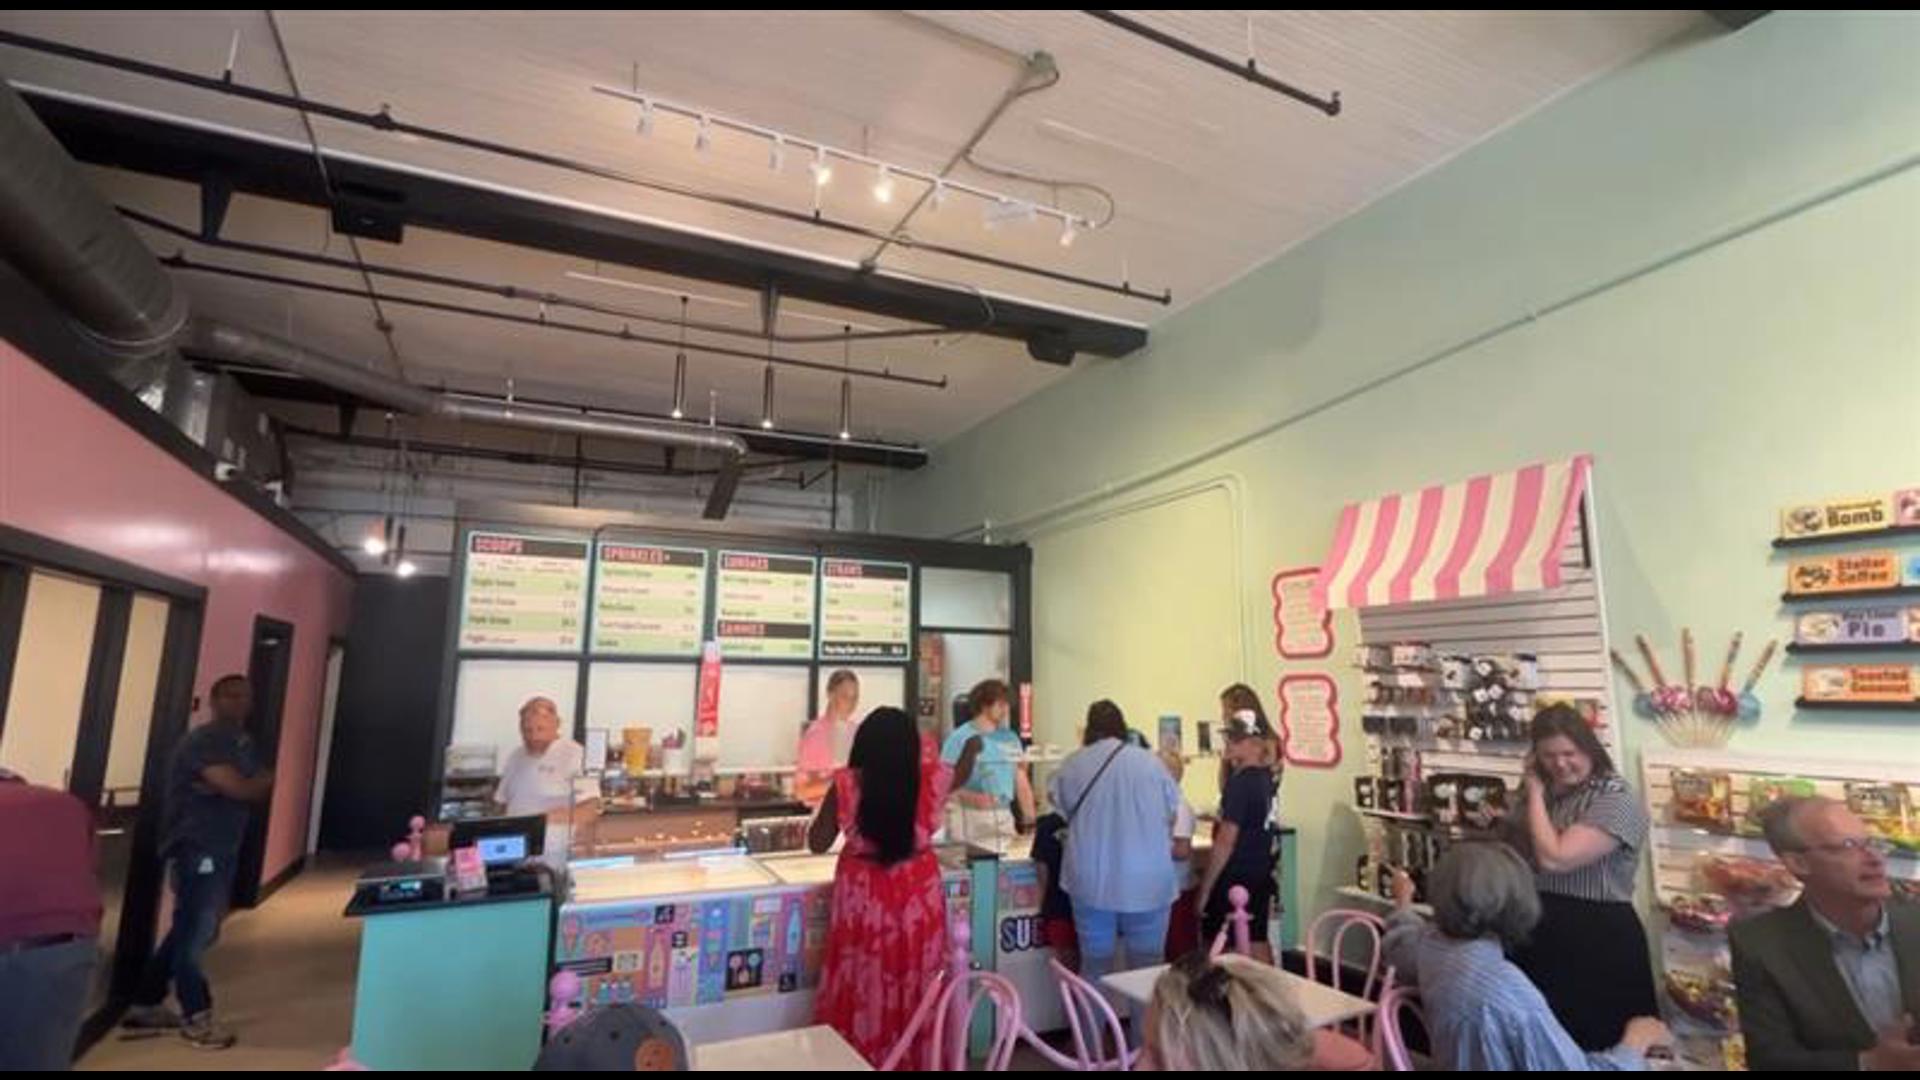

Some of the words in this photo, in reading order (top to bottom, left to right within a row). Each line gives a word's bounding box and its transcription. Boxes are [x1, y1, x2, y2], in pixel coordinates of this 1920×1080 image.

[1827, 508, 1883, 528] Bomb
[474, 536, 521, 553] SCOOPS
[1848, 621, 1884, 638] Pie
